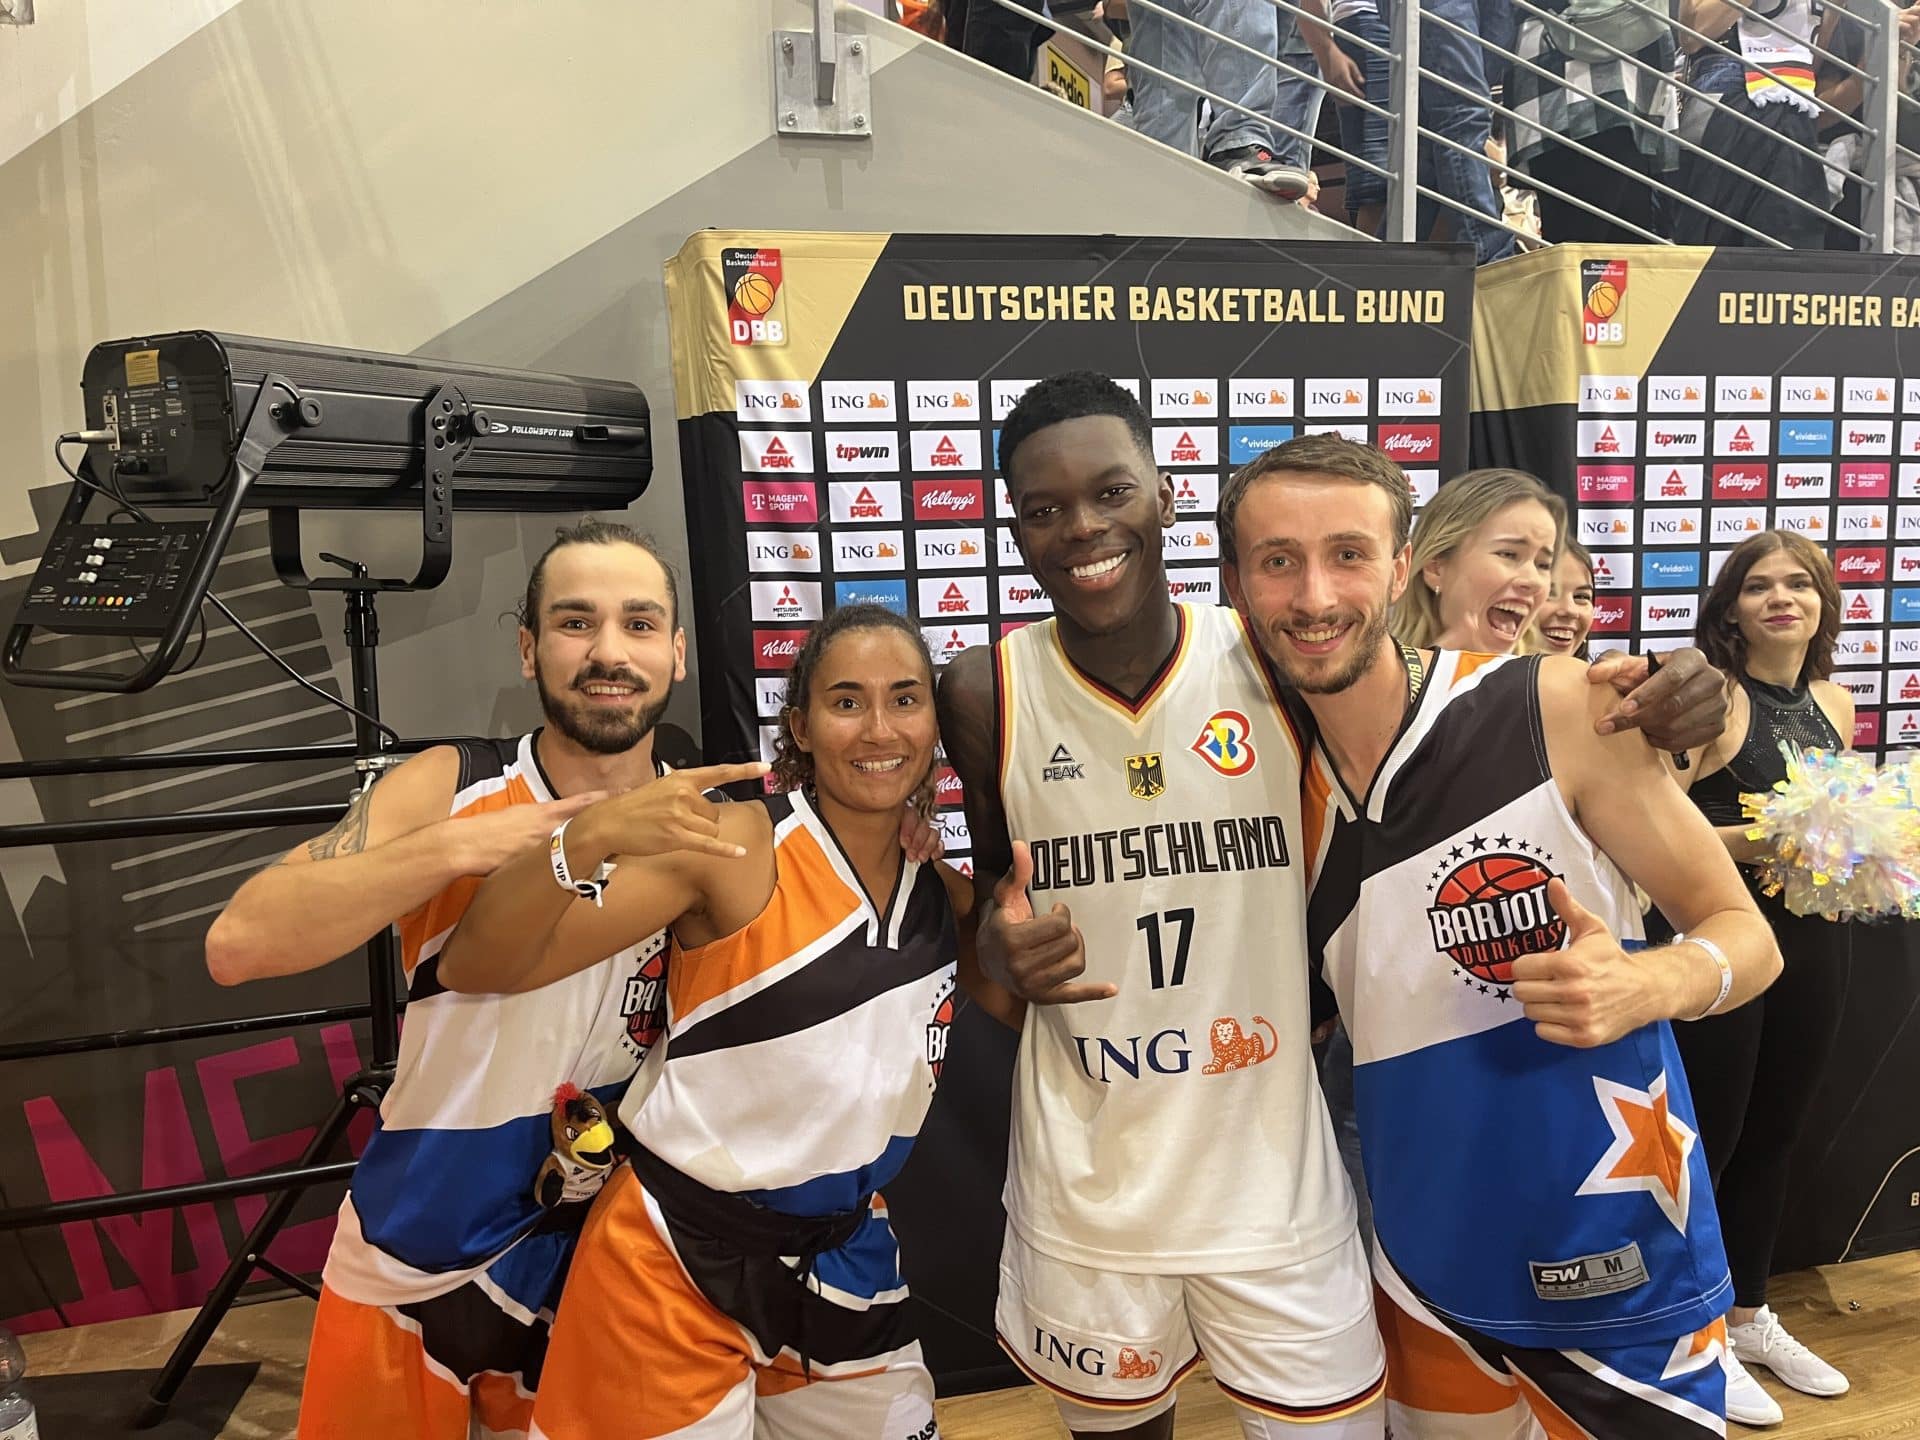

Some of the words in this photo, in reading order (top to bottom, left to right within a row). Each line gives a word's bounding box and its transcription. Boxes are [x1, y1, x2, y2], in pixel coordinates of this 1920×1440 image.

[903, 285, 1116, 321] DEUTSCHER
[1128, 286, 1345, 323] BASKETBALL
[1356, 290, 1445, 323] BUND
[1719, 292, 1881, 327] DEUTSCHER
[733, 320, 783, 341] DBB
[1585, 322, 1623, 342] DBB
[916, 393, 949, 408] ING
[1159, 392, 1189, 405] ING
[1237, 392, 1266, 405] ING
[1312, 392, 1341, 404] ING
[1385, 391, 1414, 404] ING
[1587, 388, 1612, 400] ING
[1655, 389, 1681, 401] ING
[1722, 389, 1748, 401] ING
[1787, 389, 1812, 401] ING
[1849, 389, 1873, 401] ING
[744, 394, 777, 409] ING
[831, 395, 864, 409] ING
[512, 425, 557, 437] FOLLOWSPOT
[1384, 434, 1433, 453] Kellogg's
[1655, 431, 1697, 447] tipwin
[1849, 431, 1886, 446] tipwin
[836, 444, 889, 461] tipwin
[1594, 442, 1620, 453] PEAK
[1729, 440, 1754, 452] PEAK
[760, 454, 794, 468] PEAK
[930, 453, 962, 466] PEAK
[1171, 450, 1201, 461] PEAK
[1785, 474, 1824, 489] tipwin
[1661, 486, 1687, 497] PEAK
[768, 494, 809, 503] MAGENTA
[921, 489, 976, 508] Kellogg's
[769, 502, 796, 511] SPORT
[850, 504, 883, 517] PEAK
[1583, 521, 1609, 534] ING
[1650, 520, 1676, 533] ING
[1717, 520, 1743, 532] ING
[1782, 518, 1806, 530] ING
[1843, 517, 1868, 530] ING
[1162, 535, 1191, 548] ING
[756, 546, 789, 559] ING
[841, 546, 874, 559] ING
[924, 543, 956, 556] ING
[938, 600, 970, 613] PEAK
[1648, 606, 1690, 622] tipwin
[1846, 609, 1872, 620] PEAK
[1895, 640, 1918, 652] ING
[1043, 764, 1086, 782] PEAK
[1031, 816, 1290, 891] DEUTSCHLAND
[555, 862, 567, 882] VIP
[1430, 886, 1560, 949] BARJOT
[1136, 907, 1195, 990] 17
[1072, 1028, 1192, 1083] ING
[1540, 1265, 1581, 1282] SW
[1603, 1256, 1623, 1274] M
[1034, 1325, 1106, 1376] ING
